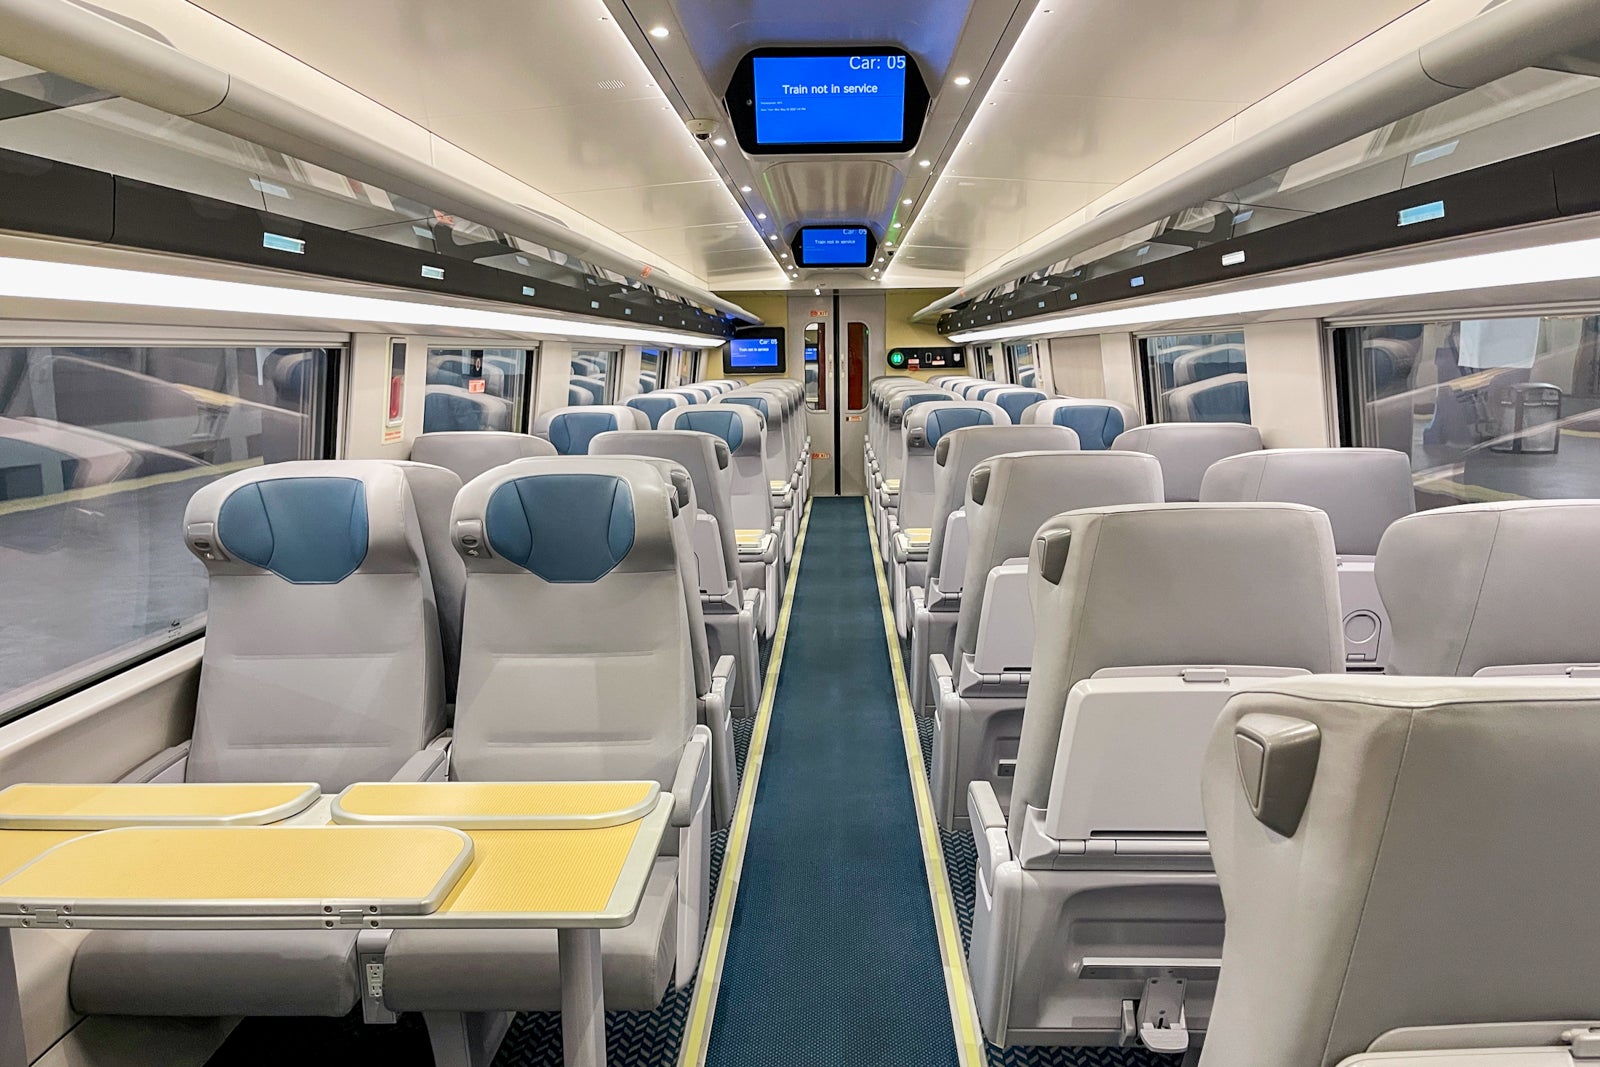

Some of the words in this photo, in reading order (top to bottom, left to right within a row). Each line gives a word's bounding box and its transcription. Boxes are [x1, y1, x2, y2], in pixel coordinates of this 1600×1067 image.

[849, 55, 881, 70] Car:
[886, 55, 906, 70] 05
[782, 84, 808, 95] Train
[811, 84, 828, 94] not
[831, 84, 840, 93] in
[843, 83, 878, 93] service
